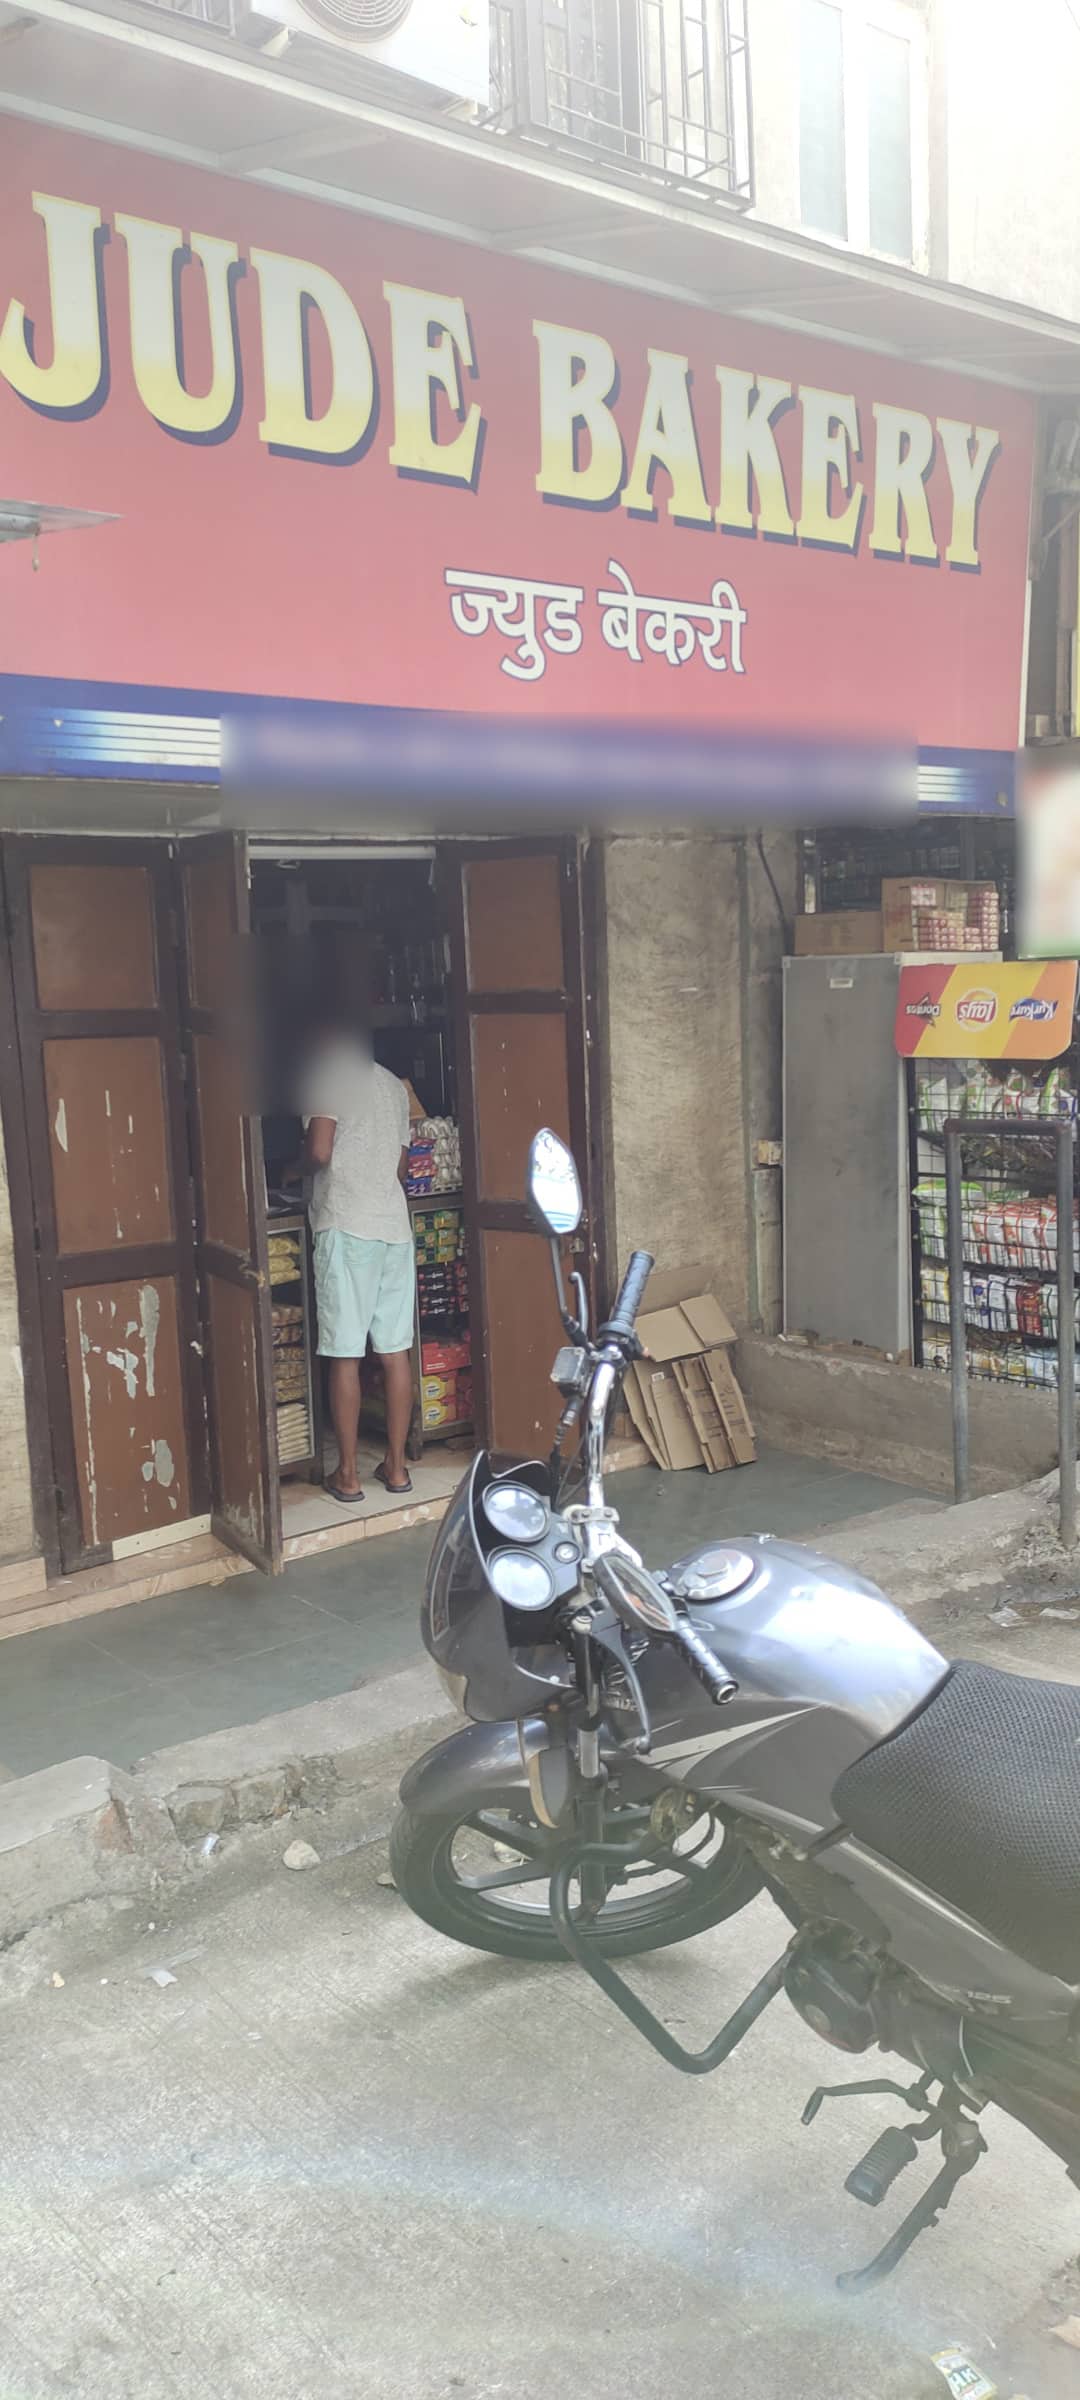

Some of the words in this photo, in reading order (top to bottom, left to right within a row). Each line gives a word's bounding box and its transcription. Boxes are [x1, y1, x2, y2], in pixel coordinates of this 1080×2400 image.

[0, 191, 484, 488] JUDE
[532, 318, 1001, 570] BAKERY
[444, 568, 585, 680] ज्युड
[596, 560, 748, 674] बेकरी
